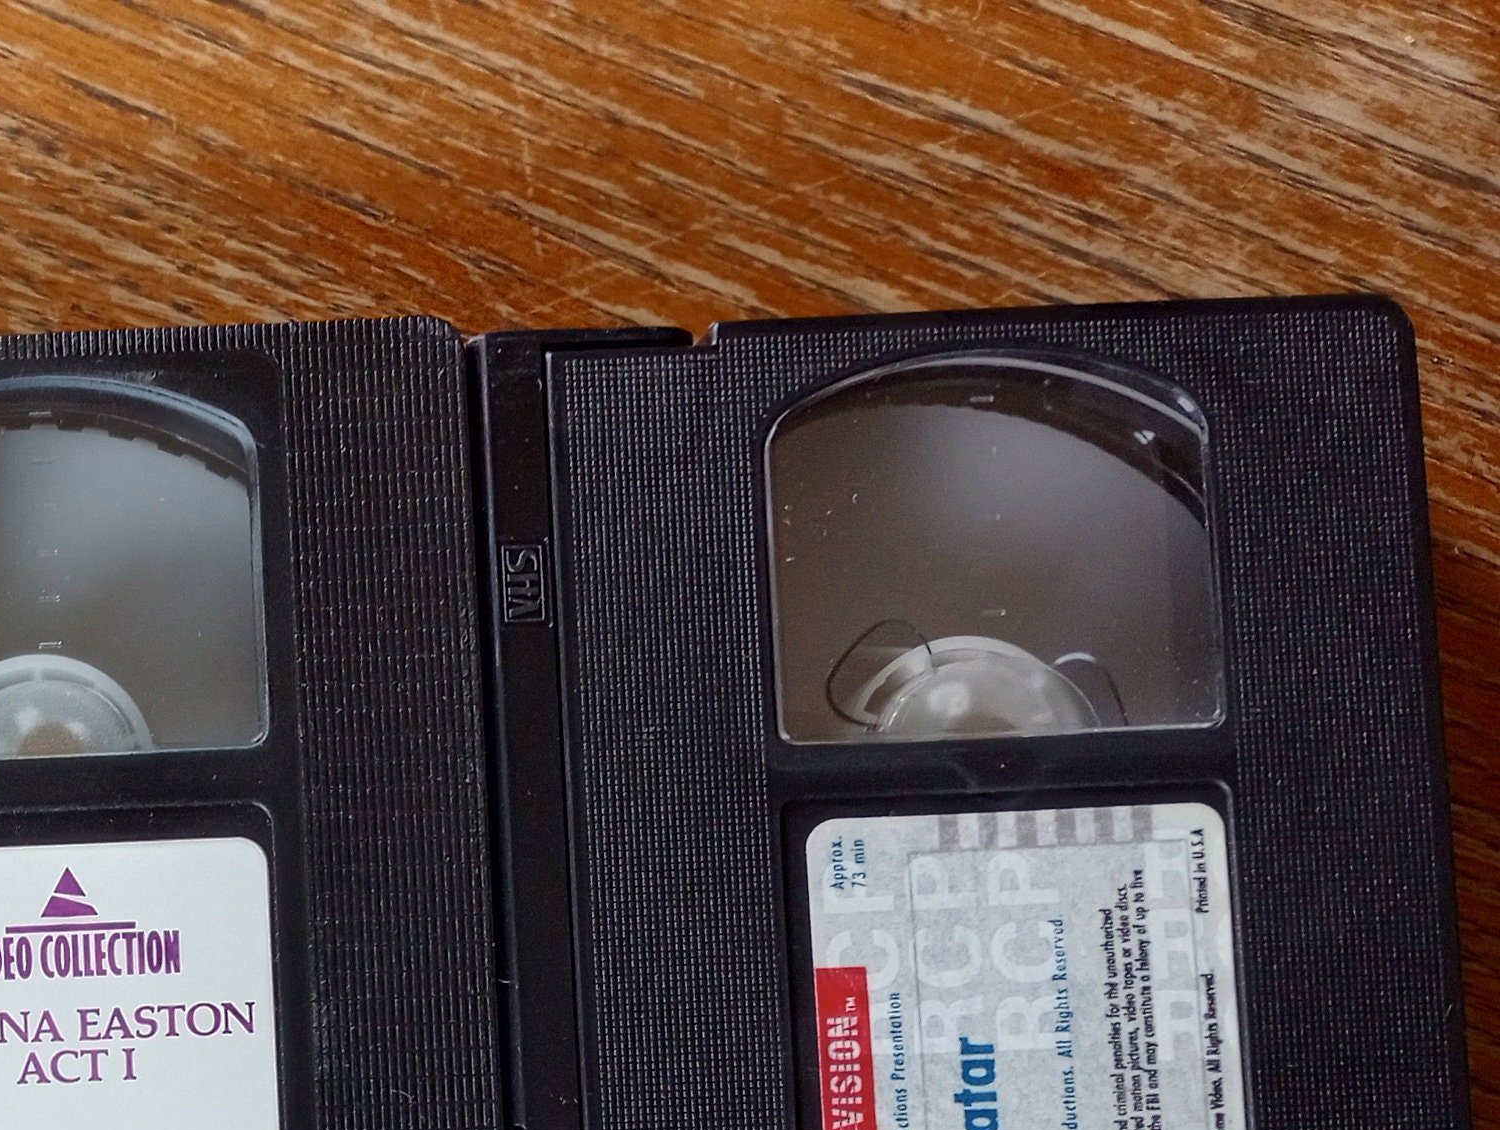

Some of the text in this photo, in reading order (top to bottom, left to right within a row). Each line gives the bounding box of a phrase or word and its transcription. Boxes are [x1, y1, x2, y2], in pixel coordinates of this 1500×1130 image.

[505, 549, 542, 619] VHS
[827, 835, 848, 890] Approx.
[850, 839, 866, 888] 73 min
[1193, 862, 1207, 873] in
[1192, 876, 1210, 914] Printed
[40, 930, 181, 979] COLLECTION
[76, 1001, 256, 1042] EASTON
[1053, 988, 1074, 1033] Rights
[888, 992, 906, 1081] Presentation
[1055, 1040, 1074, 1059] All
[16, 1047, 137, 1085] ACT I
